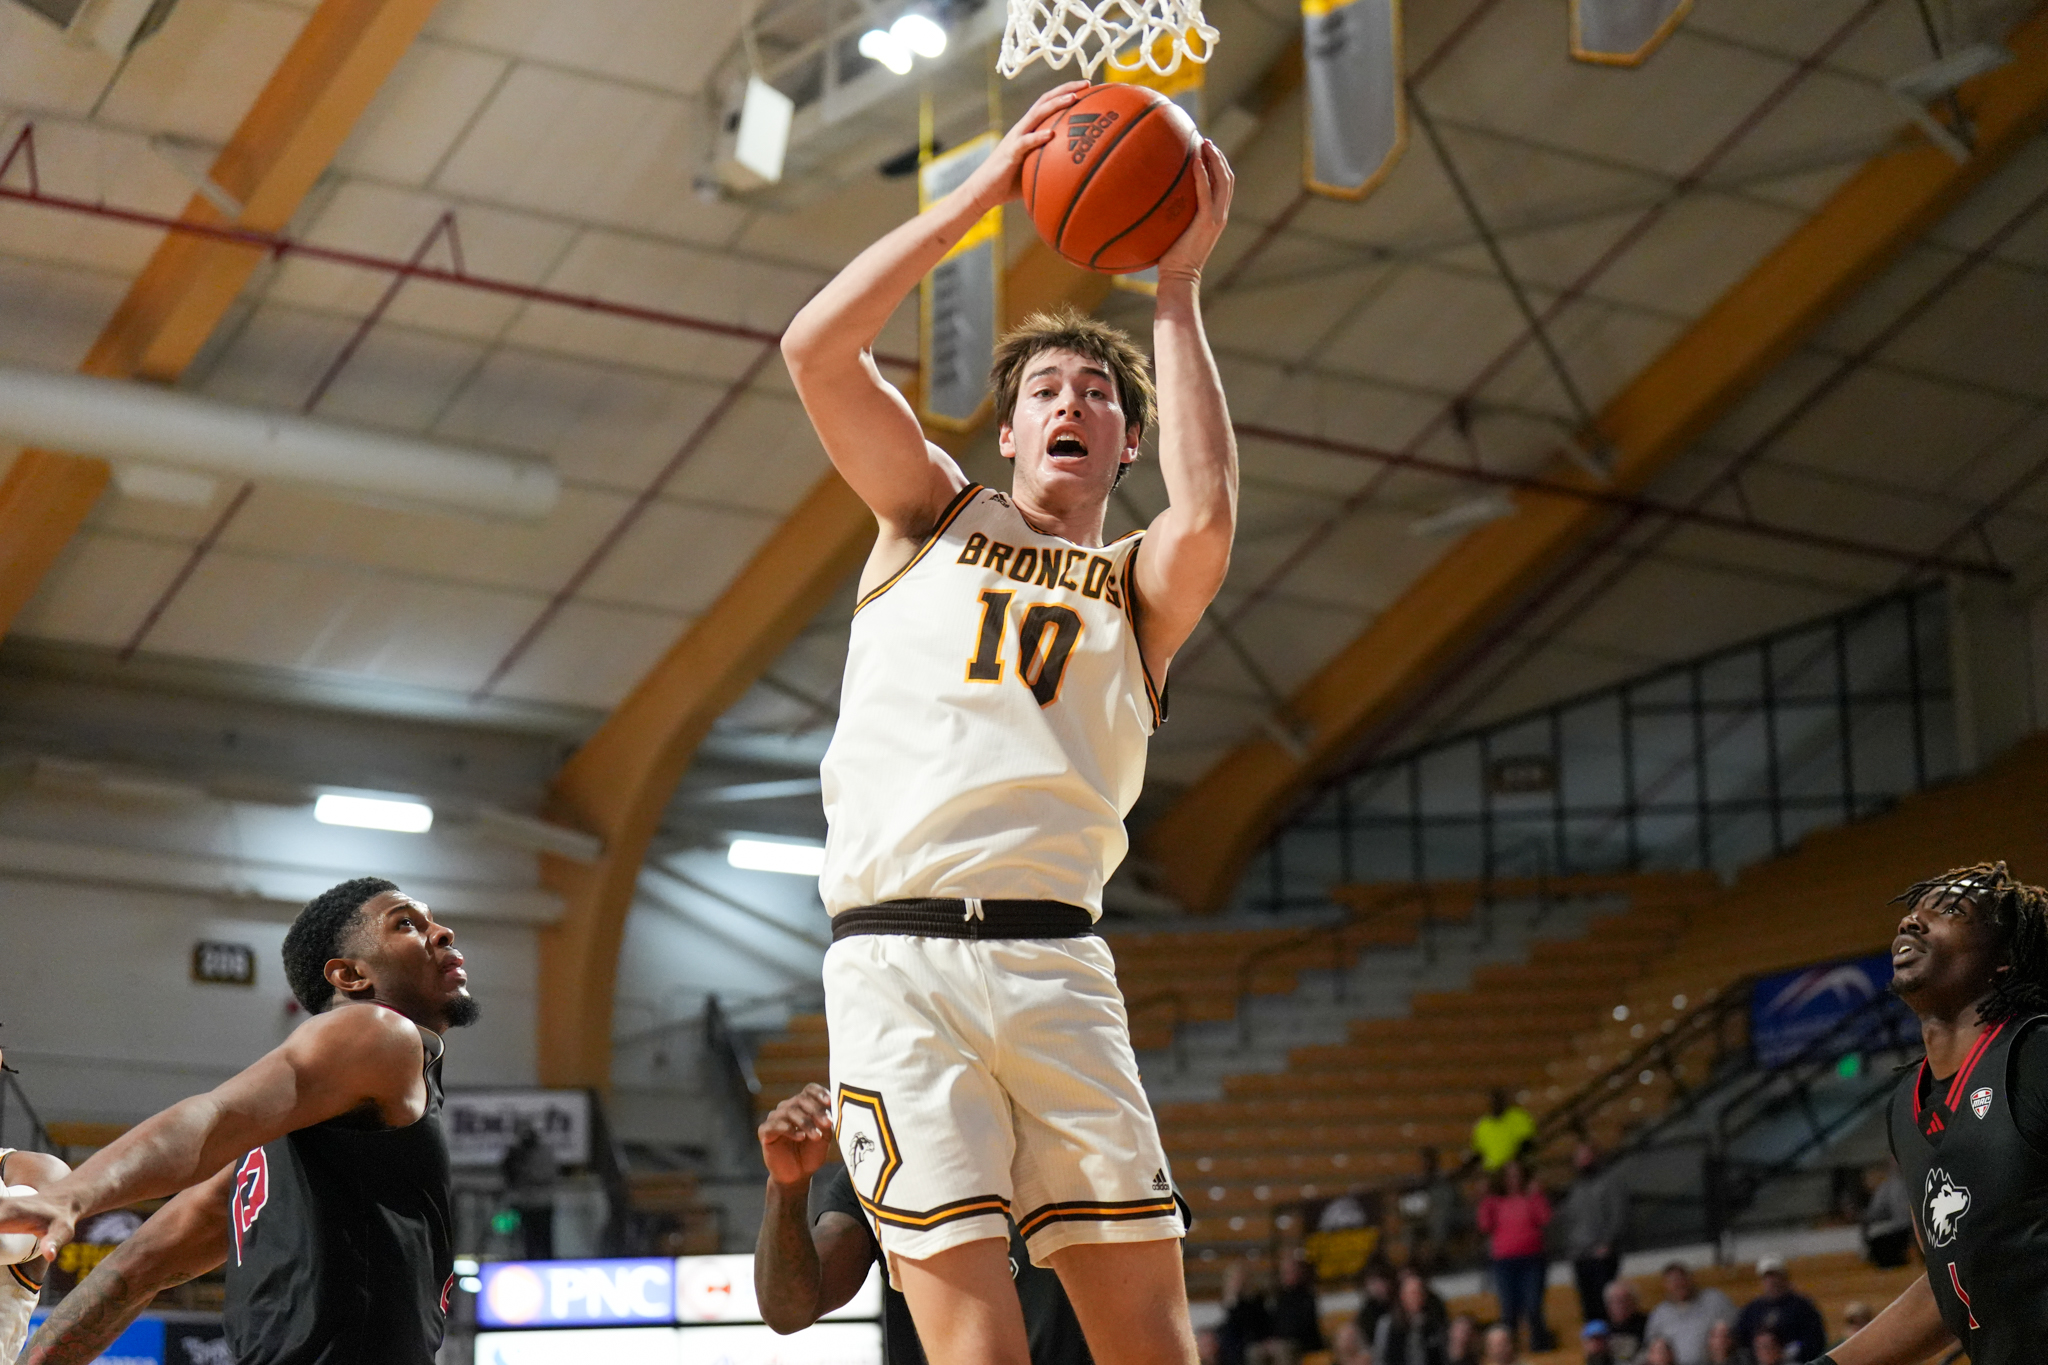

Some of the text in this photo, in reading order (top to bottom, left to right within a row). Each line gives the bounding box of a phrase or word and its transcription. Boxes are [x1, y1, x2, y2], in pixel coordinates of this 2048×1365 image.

[1072, 111, 1119, 164] adidas
[956, 532, 1122, 609] BRONCOS
[964, 588, 1085, 709] 10
[546, 1265, 671, 1319] PNC
